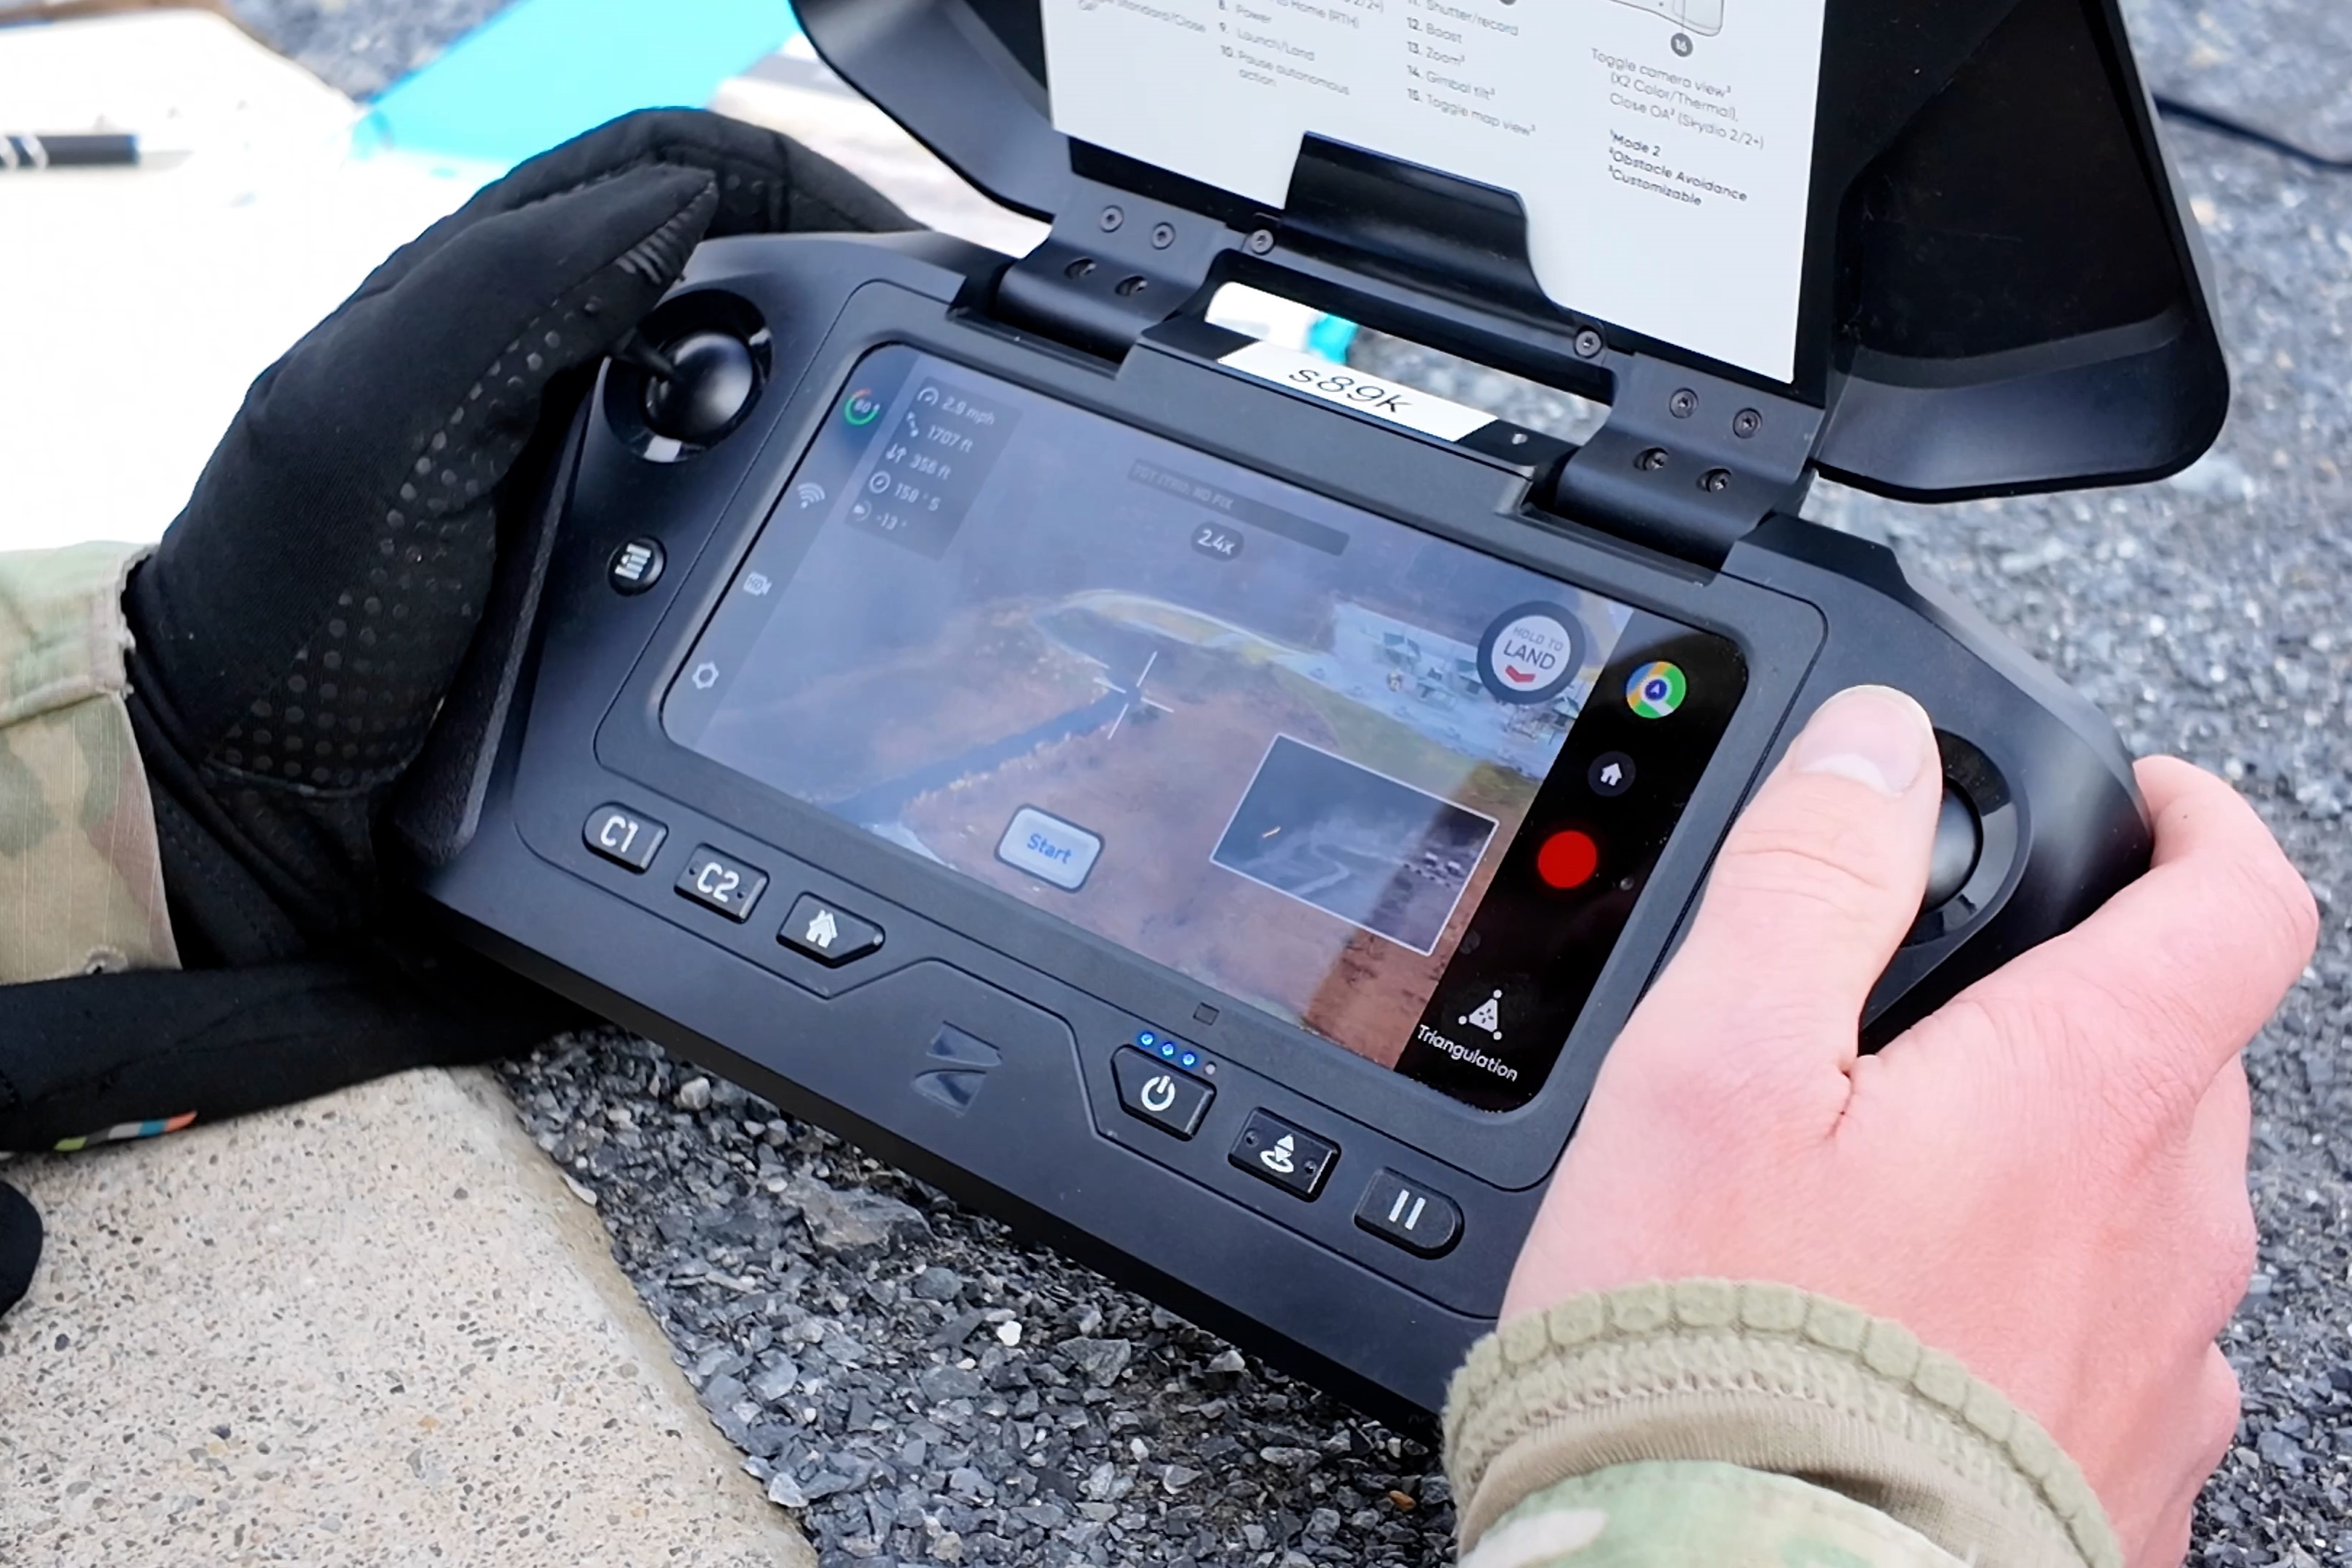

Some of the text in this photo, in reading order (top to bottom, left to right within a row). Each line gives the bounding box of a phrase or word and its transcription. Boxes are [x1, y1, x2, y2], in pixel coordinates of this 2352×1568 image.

[1236, 4, 1272, 23] Power
[1426, 0, 1519, 36] Shutter/record
[1236, 28, 1315, 61] Launch/Land
[1406, 17, 1463, 44] 12. Boost
[1406, 41, 1422, 55] 13.
[1238, 50, 1273, 71] Pause
[1275, 65, 1349, 95] autonomous
[1238, 69, 1277, 87] action
[1406, 65, 1423, 79] 14.
[1426, 70, 1471, 94] Gimbal
[1591, 47, 1636, 71] Toggle
[1639, 65, 1692, 89] camera
[1406, 88, 1423, 103] 15.
[1426, 94, 1468, 117] Toggle
[1471, 110, 1500, 127] map
[1609, 92, 1647, 113] Close
[1678, 113, 1727, 138] (Skydio
[1652, 145, 1661, 157] 2
[1676, 171, 1747, 201] Avoidance
[965, 408, 995, 427] mph
[928, 425, 973, 453] 1707 ft
[937, 465, 952, 481] ft
[1512, 626, 1564, 652] HOLD TO
[1503, 640, 1556, 670] LAND
[600, 815, 639, 853] C1
[1026, 833, 1071, 864] Start
[697, 862, 740, 903] C2
[1417, 1024, 1519, 1082] Triangulation
